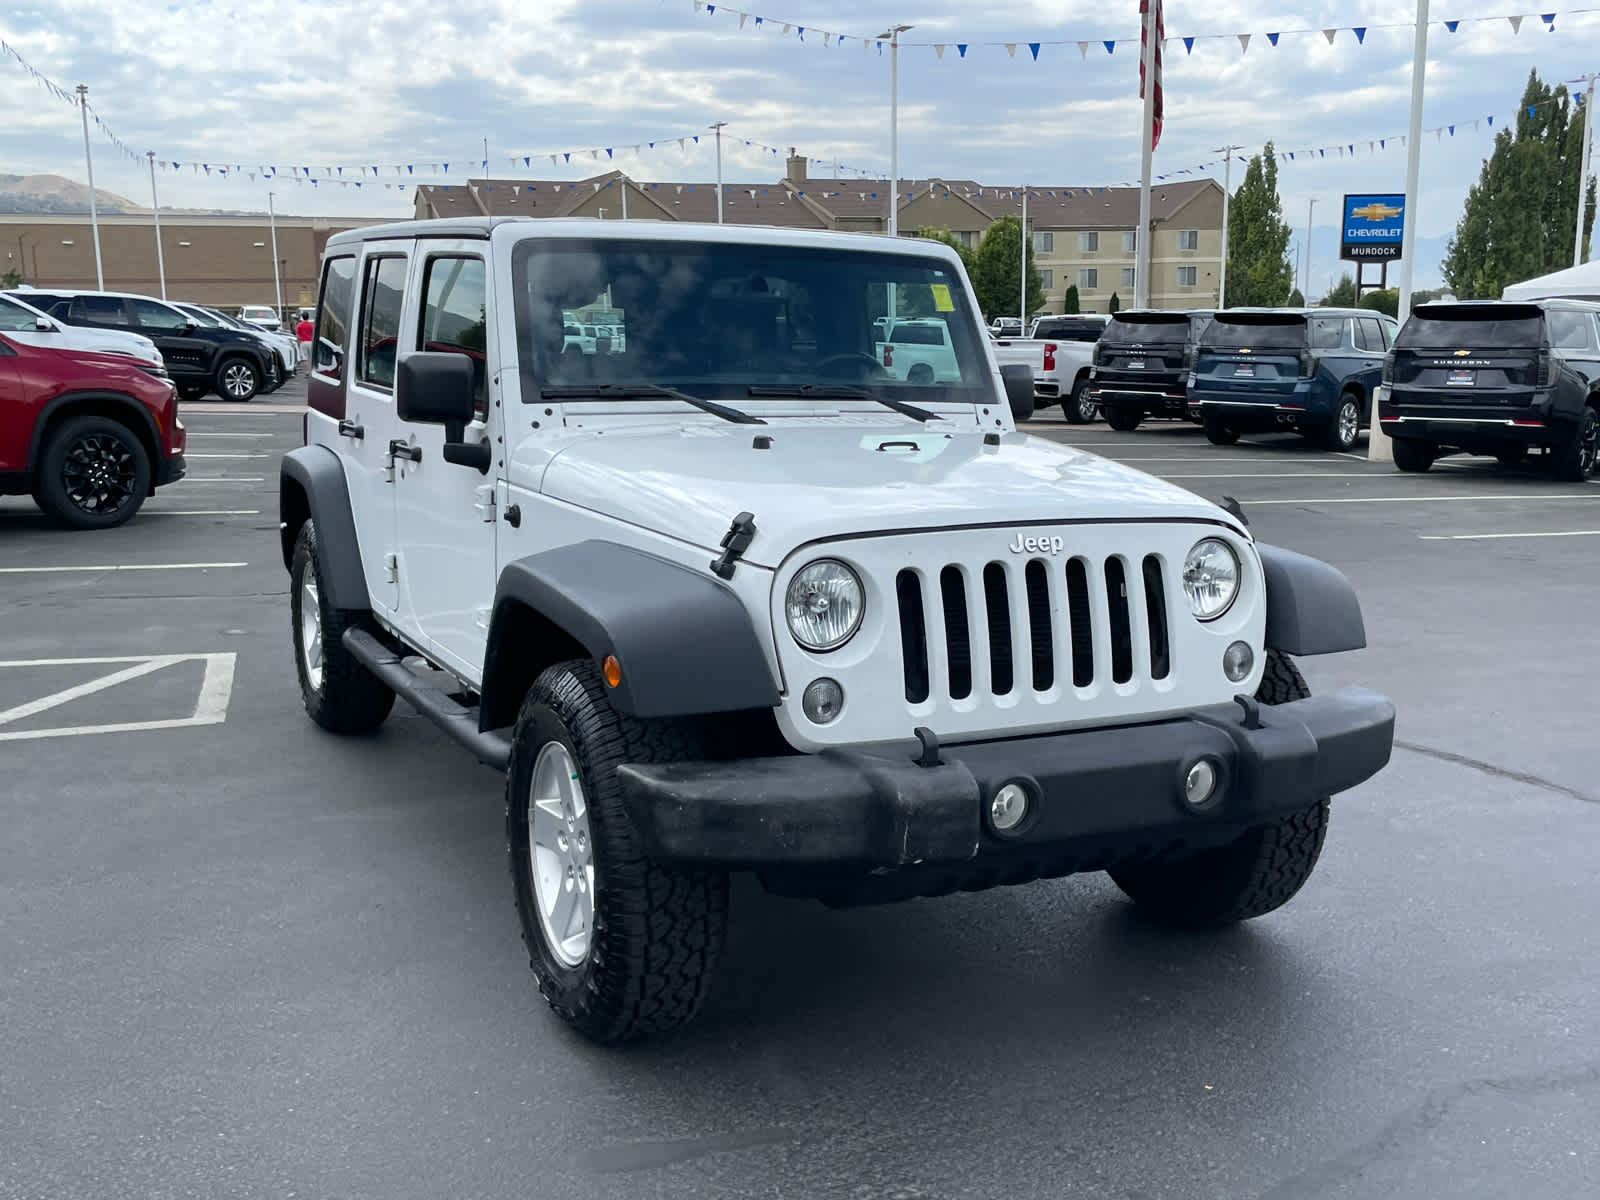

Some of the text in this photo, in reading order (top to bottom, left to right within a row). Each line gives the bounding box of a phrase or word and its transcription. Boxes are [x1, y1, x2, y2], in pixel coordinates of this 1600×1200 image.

[1348, 228, 1402, 237] CHEVROLET
[1351, 247, 1396, 255] MURDOCK
[1008, 533, 1064, 556] Jeep
